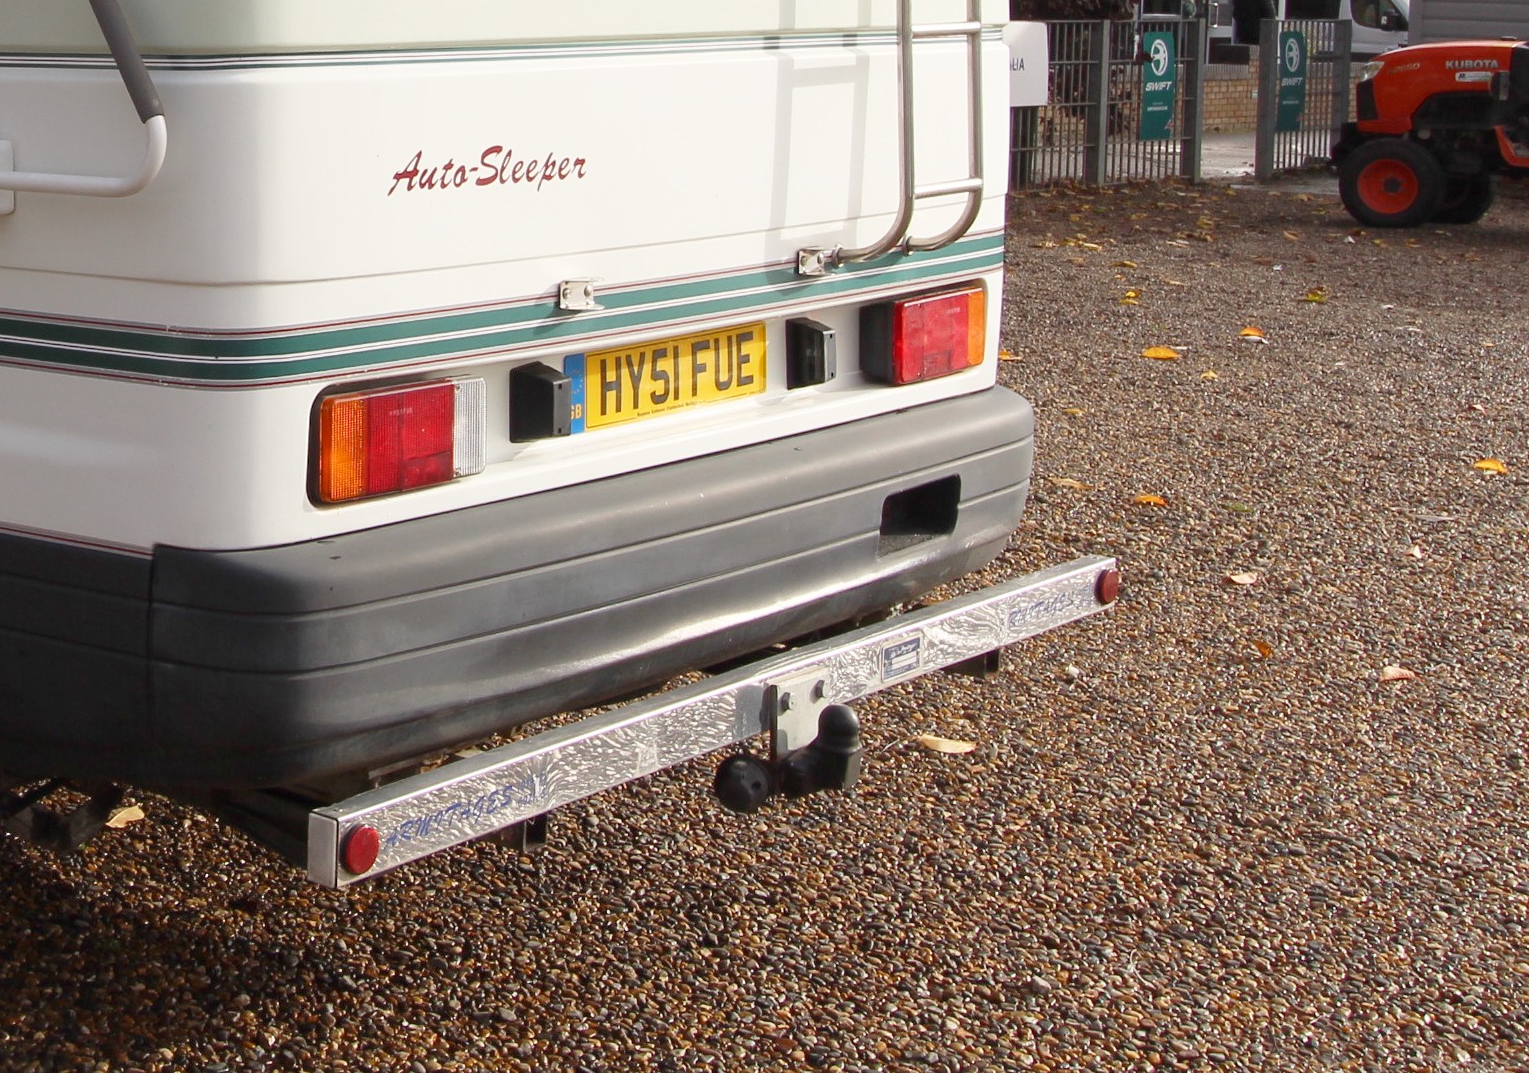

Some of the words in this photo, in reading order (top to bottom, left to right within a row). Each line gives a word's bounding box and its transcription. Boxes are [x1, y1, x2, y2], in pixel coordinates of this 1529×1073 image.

[1445, 59, 1499, 69] KUBOTA
[1145, 81, 1172, 92] SWIFT
[1281, 77, 1303, 86] SWIFT
[387, 145, 586, 197] Auto-Sleeper
[600, 345, 680, 416] HY51
[691, 330, 754, 397] FUE
